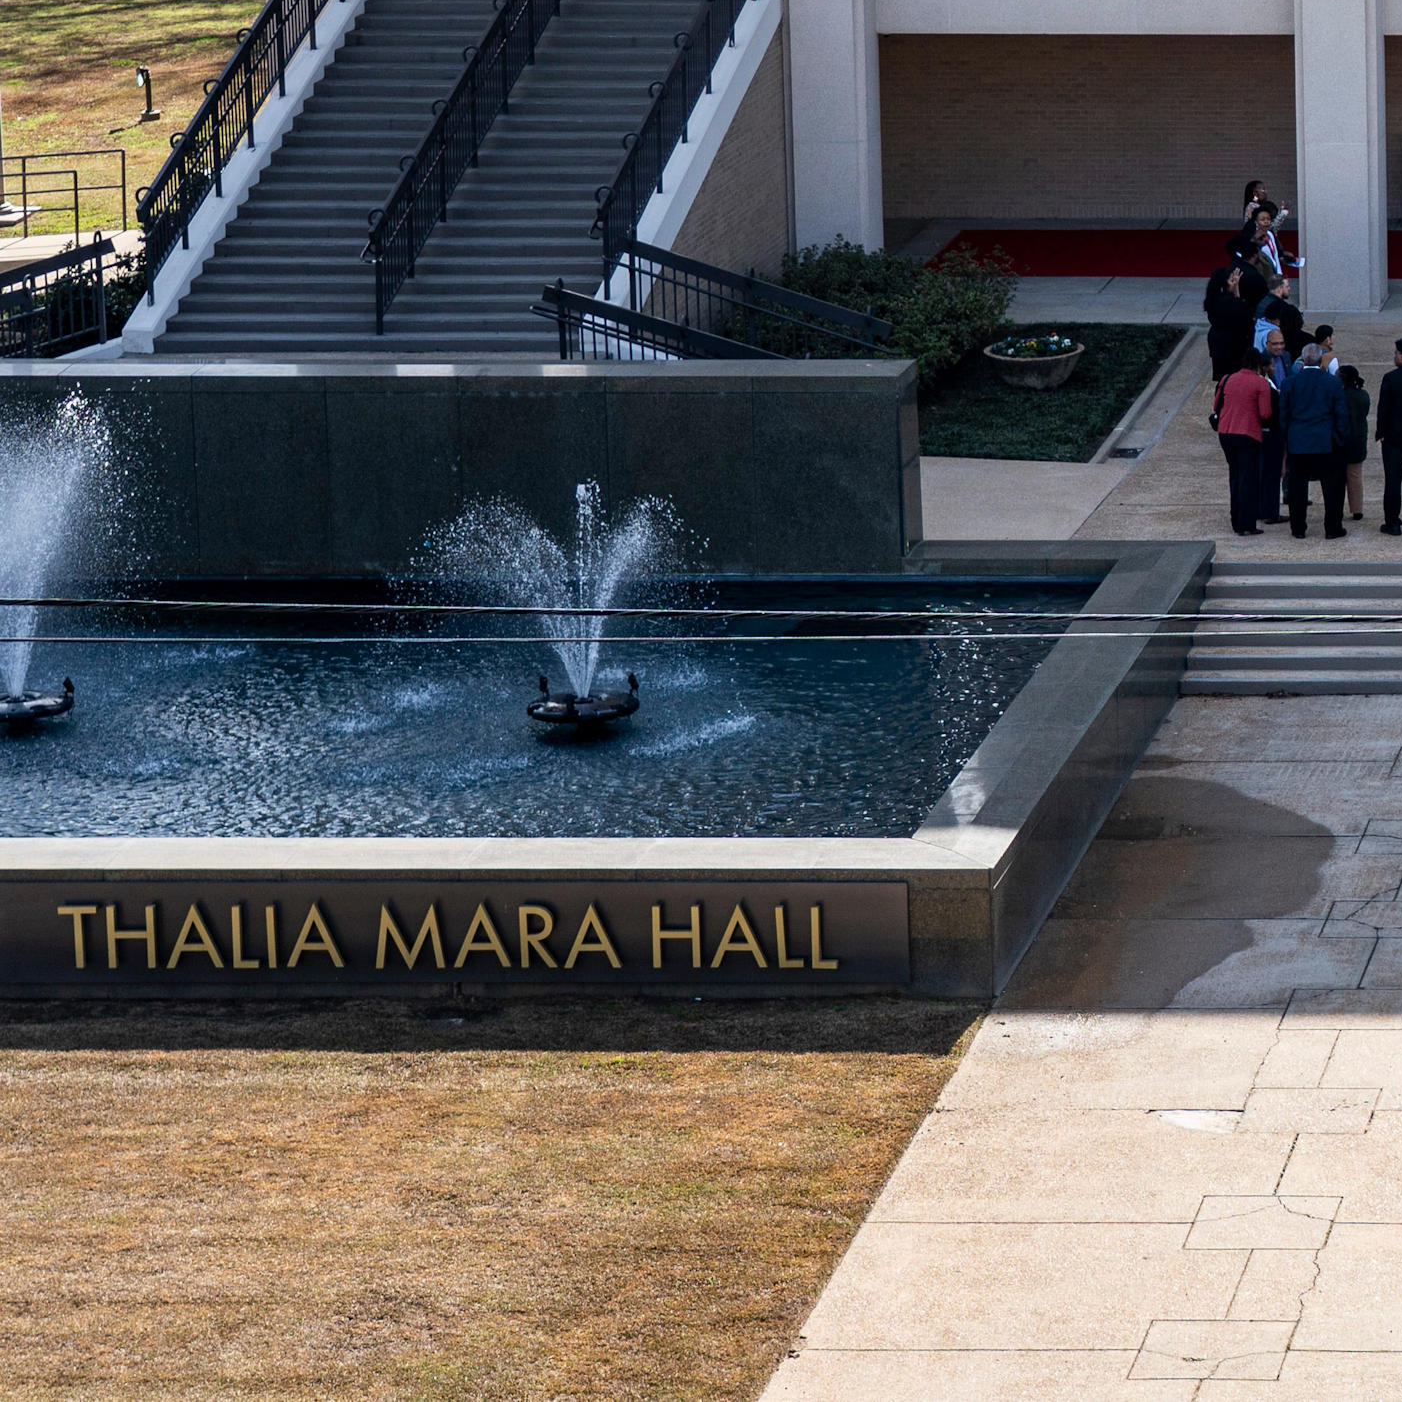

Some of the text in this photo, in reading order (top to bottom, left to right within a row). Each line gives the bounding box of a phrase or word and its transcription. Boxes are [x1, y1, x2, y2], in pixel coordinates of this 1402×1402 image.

[57, 903, 839, 971] THALIA MARA HALL
